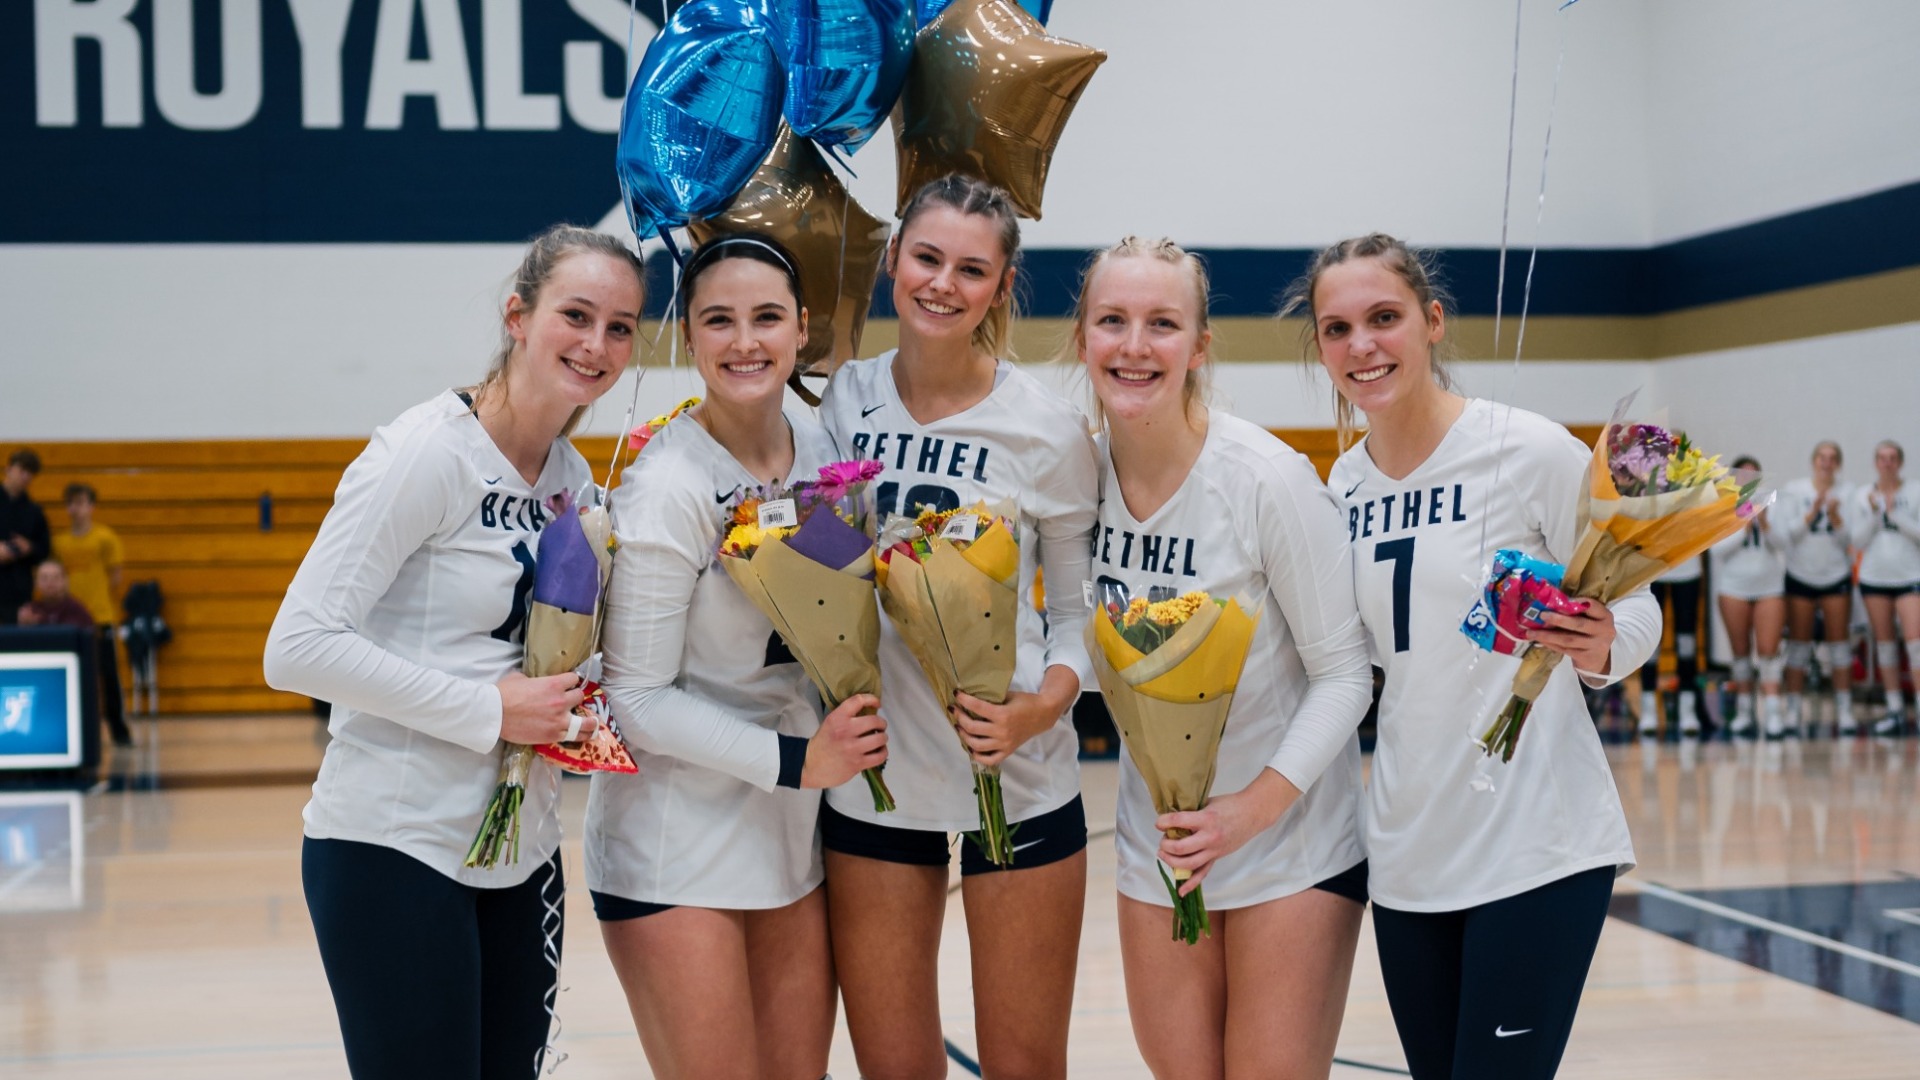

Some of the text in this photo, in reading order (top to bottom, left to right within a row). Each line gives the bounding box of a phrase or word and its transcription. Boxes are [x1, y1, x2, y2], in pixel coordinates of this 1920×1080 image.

[853, 432, 990, 484] BETHEL
[481, 491, 548, 533] BETH
[1350, 483, 1467, 543] BETHEL
[1373, 536, 1416, 654] 7
